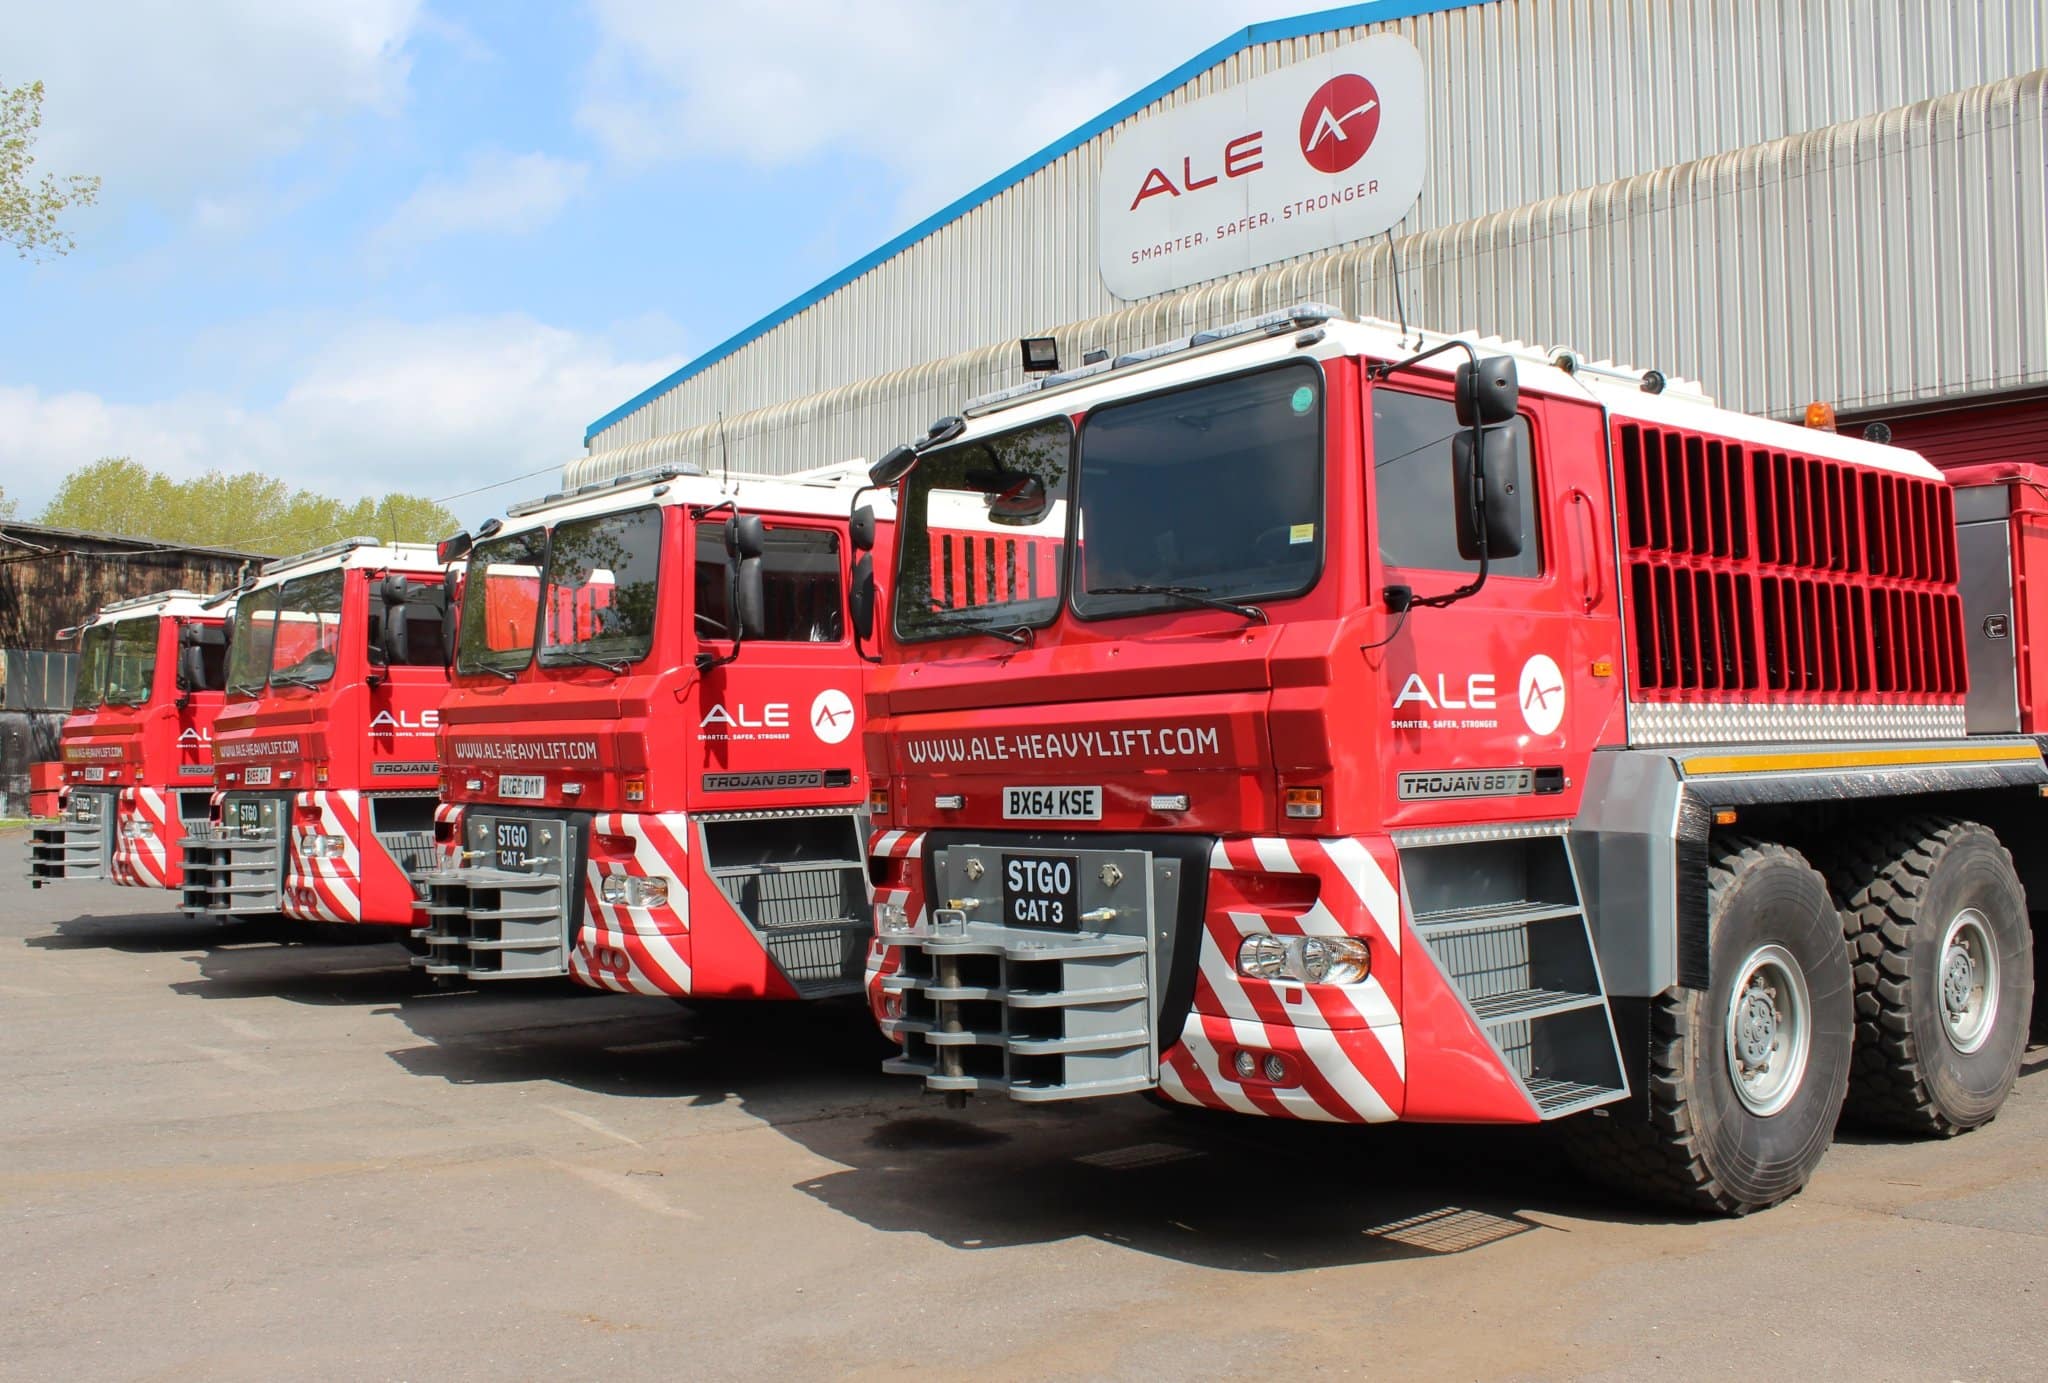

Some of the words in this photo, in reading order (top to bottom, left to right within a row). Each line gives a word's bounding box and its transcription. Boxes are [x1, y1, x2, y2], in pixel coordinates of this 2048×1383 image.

[1130, 130, 1264, 211] ALE
[1131, 232, 1209, 264] SMARTER,
[1216, 212, 1275, 240] SAFER,
[1283, 179, 1379, 219] STRONGER
[1392, 673, 1496, 709] ALE
[369, 710, 439, 728] ALE
[699, 703, 789, 727] ALE
[1461, 719, 1498, 728] STRONGER
[178, 727, 212, 741] AL
[908, 727, 1219, 763] WWW.ALE-HEAVYLIFT.COM
[455, 741, 597, 760] WWW.ALE-HEAVYLIFT.COM
[707, 775, 774, 788] TROJAN
[1404, 776, 1480, 794] TROJAN
[241, 804, 257, 821] STGO
[1010, 790, 1054, 815] BX64
[1059, 790, 1094, 815] KSE
[498, 825, 527, 847] STGO
[501, 851, 518, 866] CAT
[1008, 860, 1071, 895] STGO
[1015, 898, 1049, 923] CAT
[1052, 901, 1063, 924] 3
